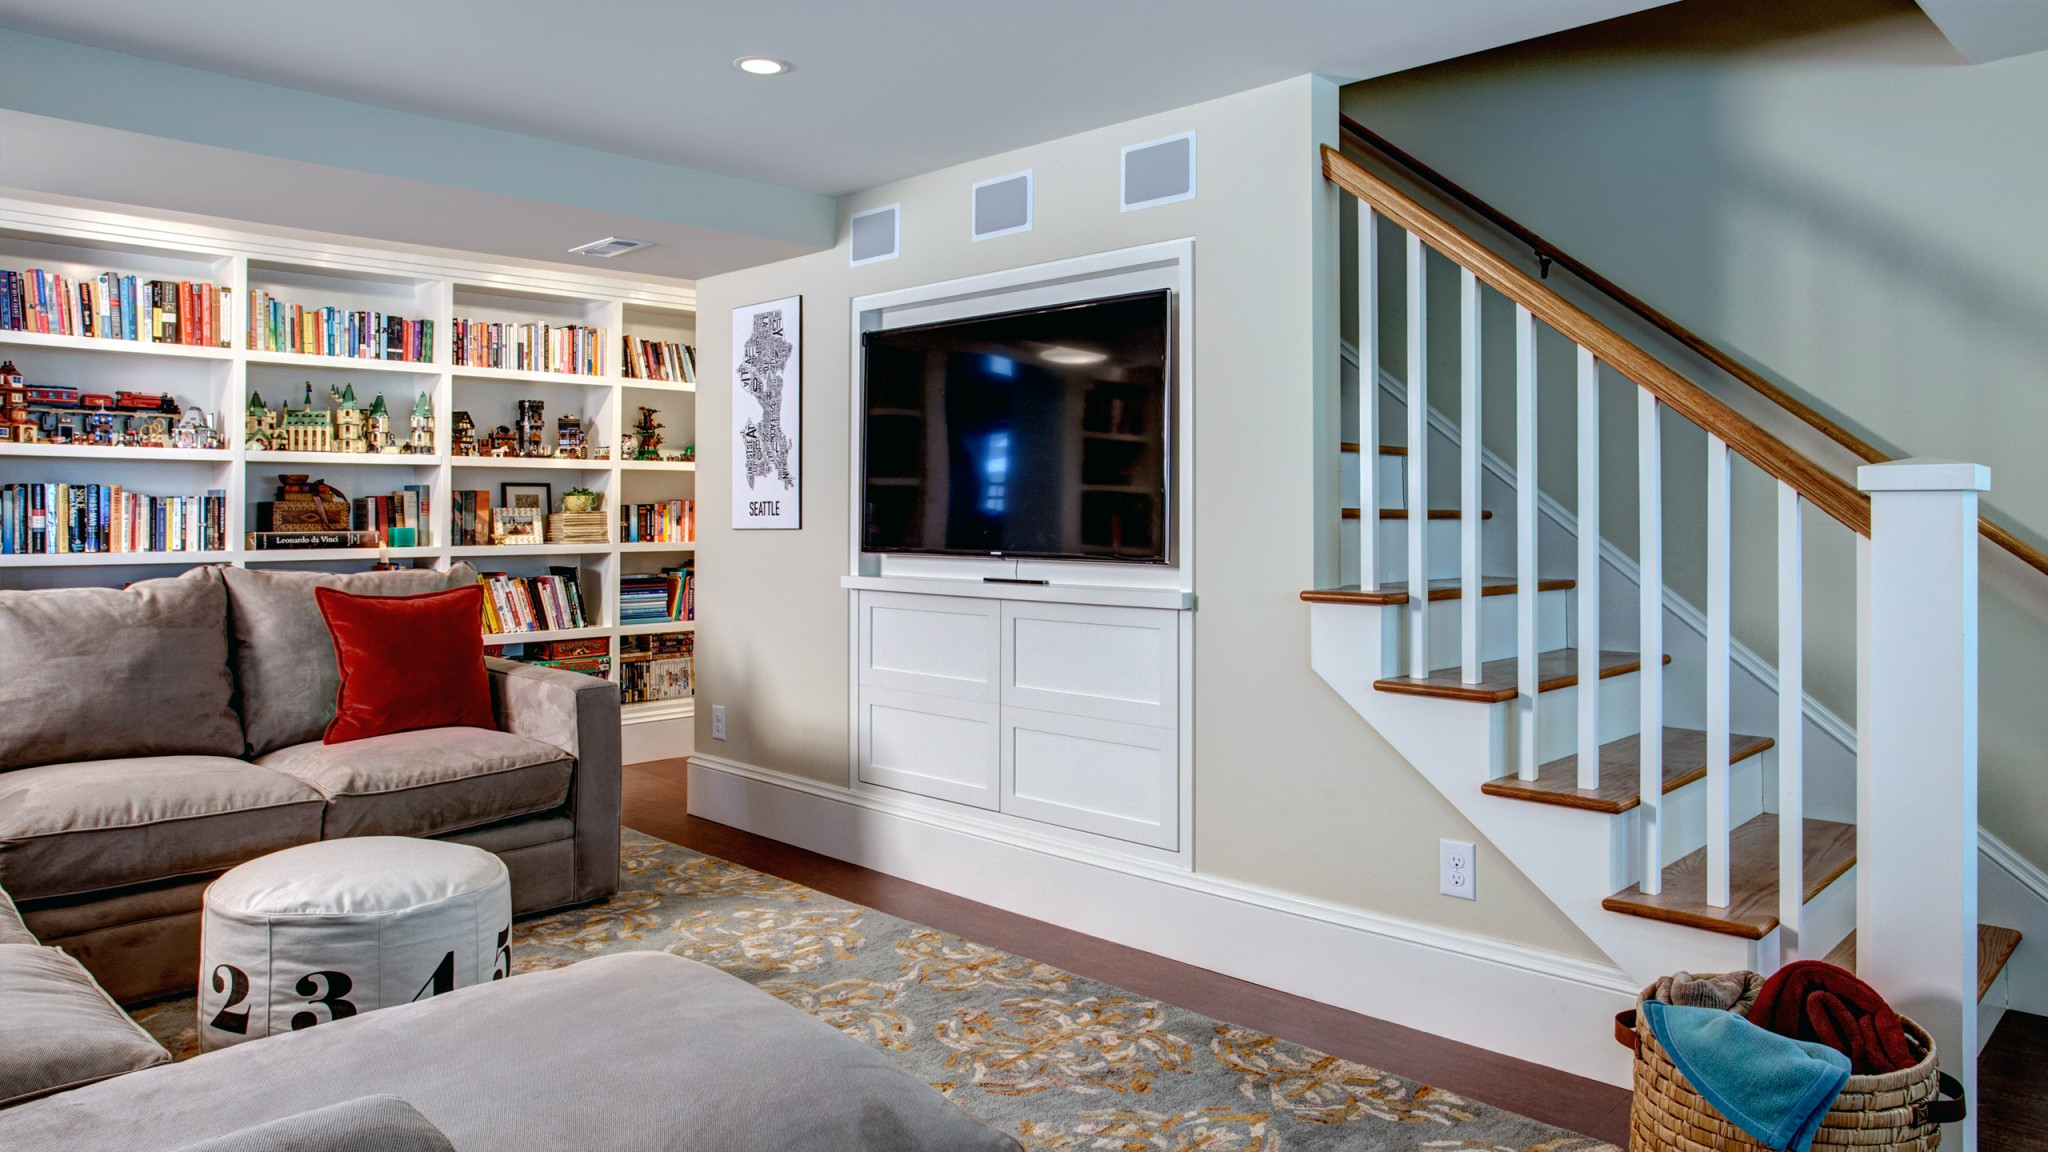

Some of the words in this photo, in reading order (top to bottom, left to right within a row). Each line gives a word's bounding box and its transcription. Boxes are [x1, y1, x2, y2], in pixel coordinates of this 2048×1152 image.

[749, 501, 780, 516] SEATTLE
[276, 536, 310, 544] Leonardo
[320, 535, 339, 543] Vinci
[559, 639, 602, 653] Cathedral
[210, 963, 252, 1035] 2
[290, 970, 358, 1031] 3
[411, 950, 455, 1004] 4
[492, 922, 512, 980] 5
